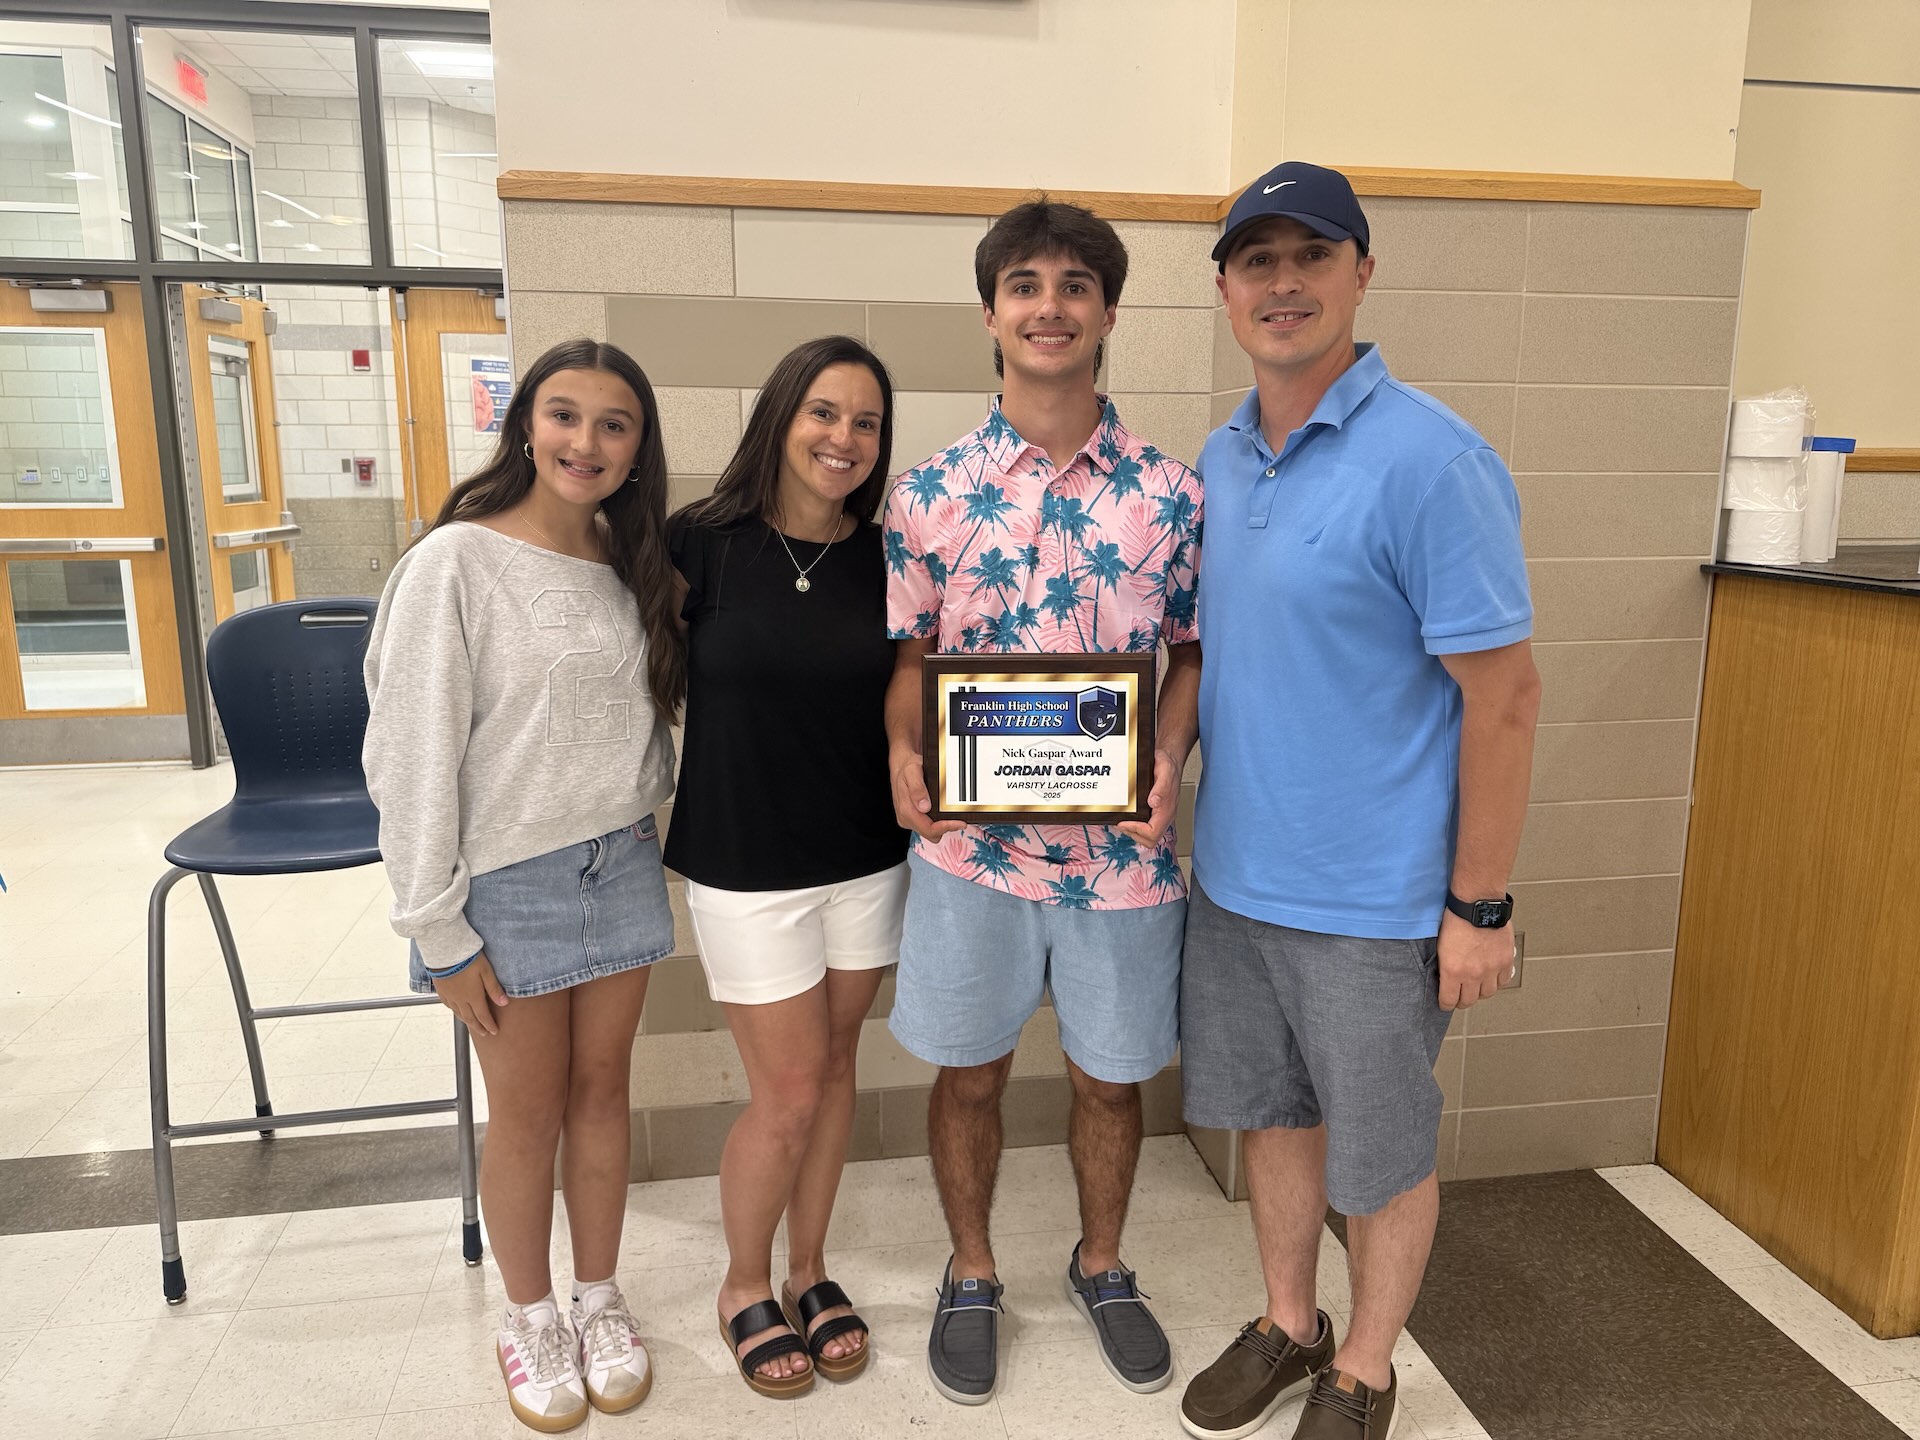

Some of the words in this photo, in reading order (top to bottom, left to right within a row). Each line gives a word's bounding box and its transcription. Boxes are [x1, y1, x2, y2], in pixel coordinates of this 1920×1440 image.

[960, 700, 1005, 711] Franklin
[1008, 700, 1033, 713] High
[1035, 700, 1069, 711] School
[966, 715, 1063, 728] PANTHERS
[1002, 748, 1025, 758] Nick
[1028, 748, 1066, 760] Gaspar
[1069, 748, 1103, 758] Award
[993, 765, 1052, 776] JORDAN
[1055, 765, 1112, 776] GASPAR
[1006, 781, 1046, 789] VARSITY
[1048, 781, 1099, 789] LACROSSE
